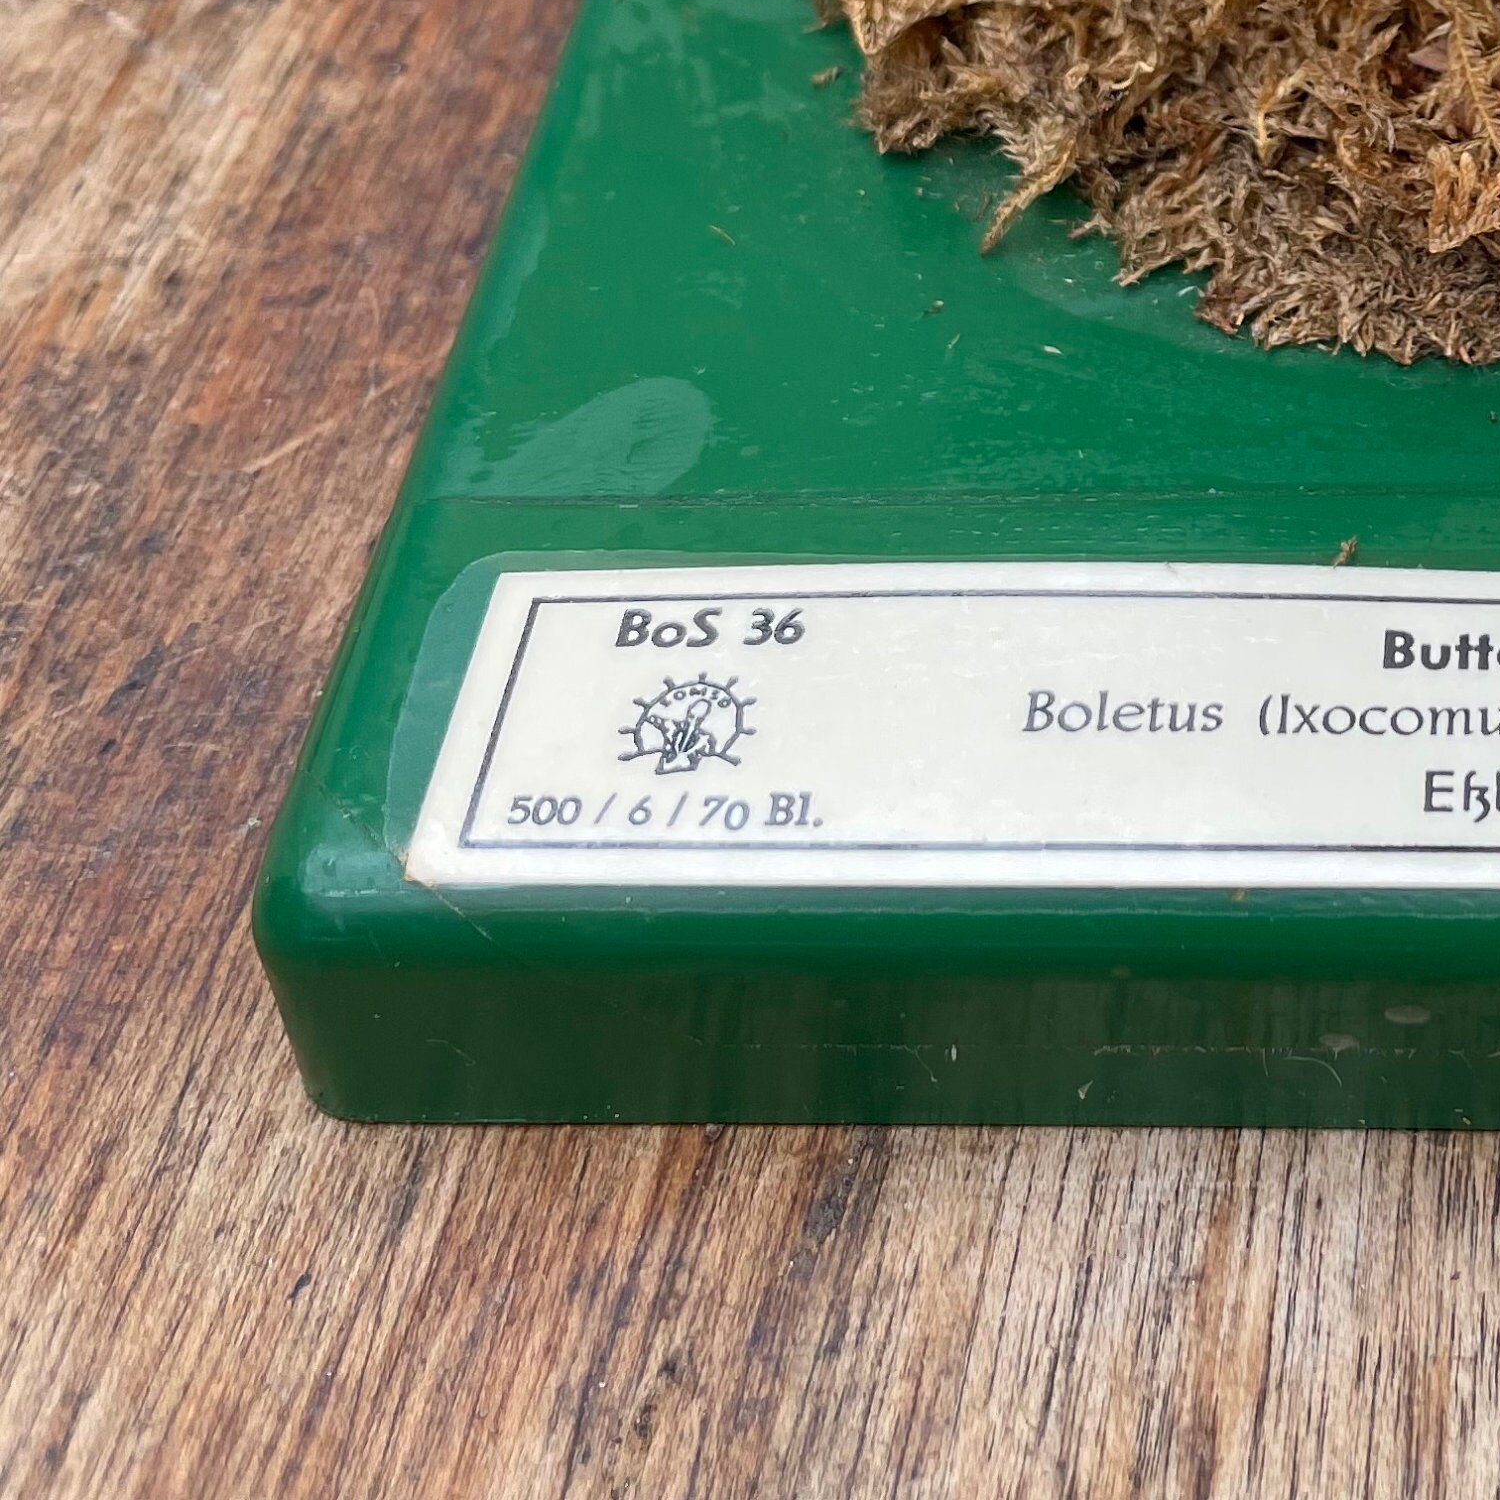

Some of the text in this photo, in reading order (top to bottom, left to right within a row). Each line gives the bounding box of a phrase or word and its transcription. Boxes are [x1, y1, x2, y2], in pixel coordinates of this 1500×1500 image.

[615, 607, 806, 649] BoS 36
[1021, 690, 1224, 735] Boletus
[764, 792, 824, 828] Bl.
